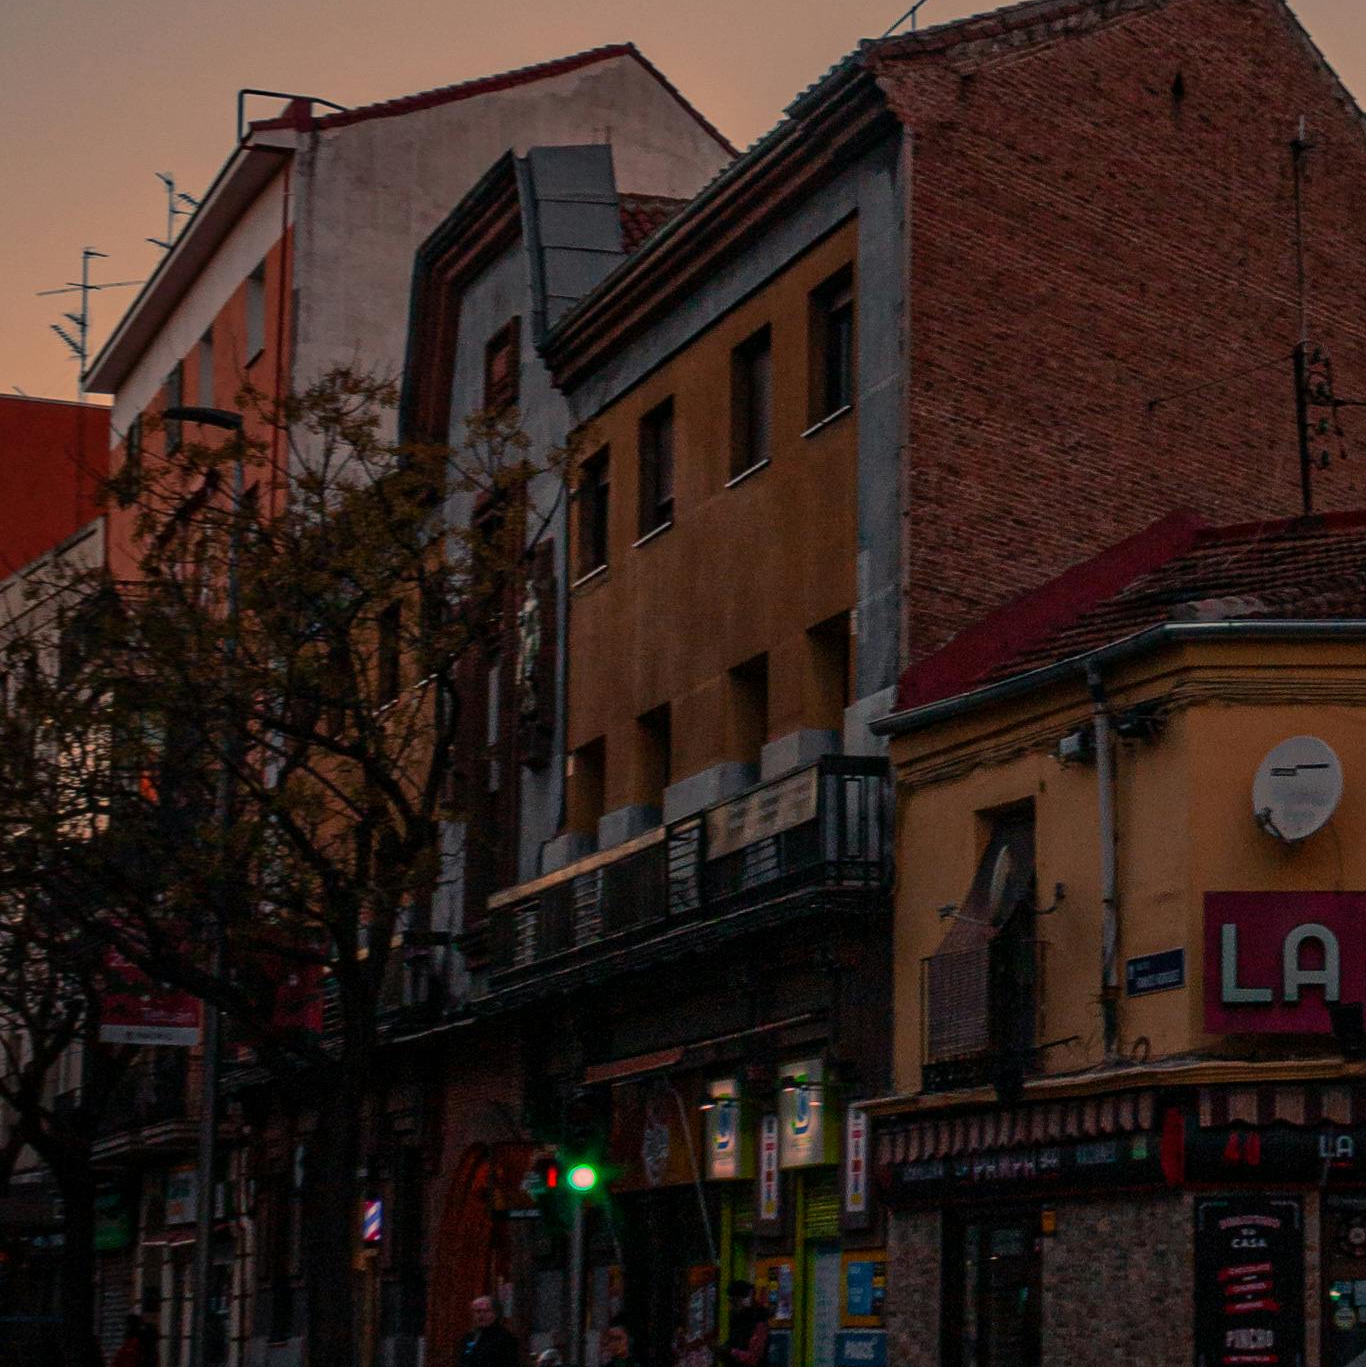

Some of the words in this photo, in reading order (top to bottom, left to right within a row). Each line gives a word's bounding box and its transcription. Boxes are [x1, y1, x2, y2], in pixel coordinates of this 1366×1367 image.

[1220, 922, 1341, 1005] LA
[1318, 1135, 1354, 1158] LA
[1230, 1237, 1268, 1249] CASA
